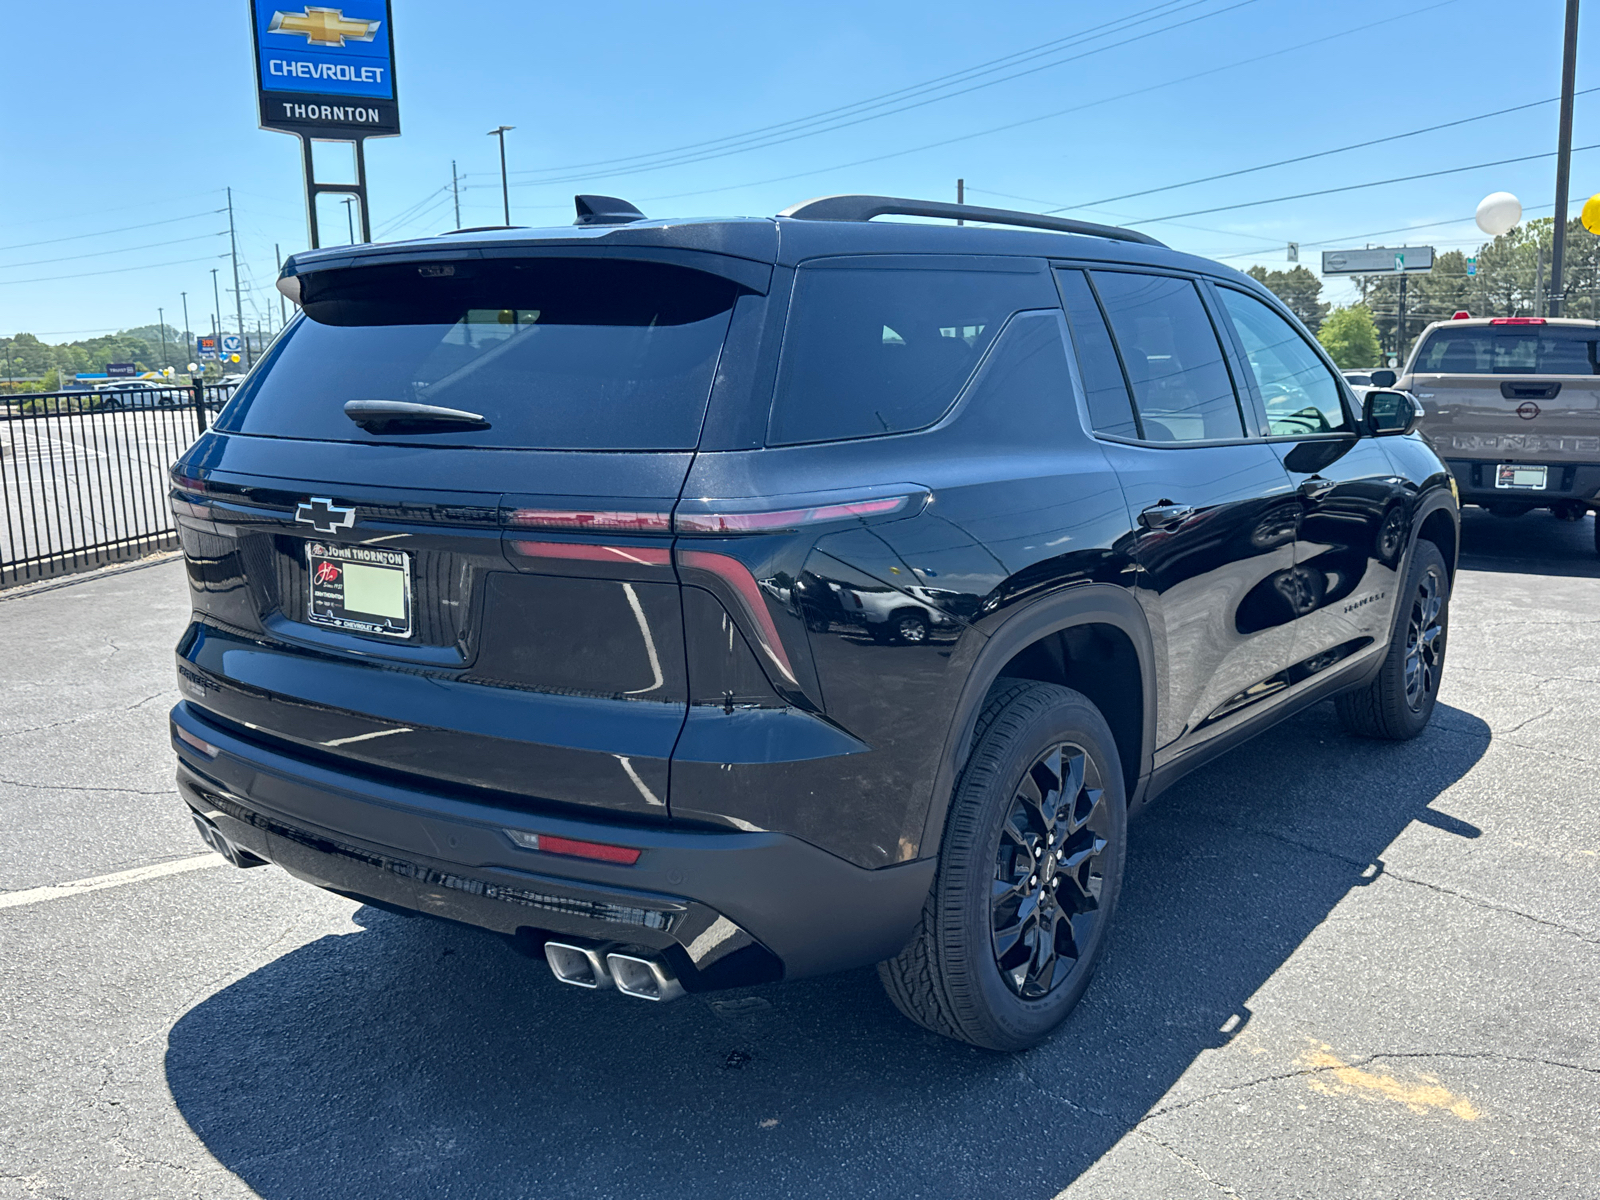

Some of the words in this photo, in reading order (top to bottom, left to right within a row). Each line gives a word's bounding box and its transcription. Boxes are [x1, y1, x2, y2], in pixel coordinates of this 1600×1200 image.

[269, 59, 384, 83] CHEVROLET
[283, 103, 379, 122] THORNTON
[328, 546, 351, 558] JOHN
[352, 549, 402, 565] THORNTON
[343, 621, 373, 631] CHEVROLET
